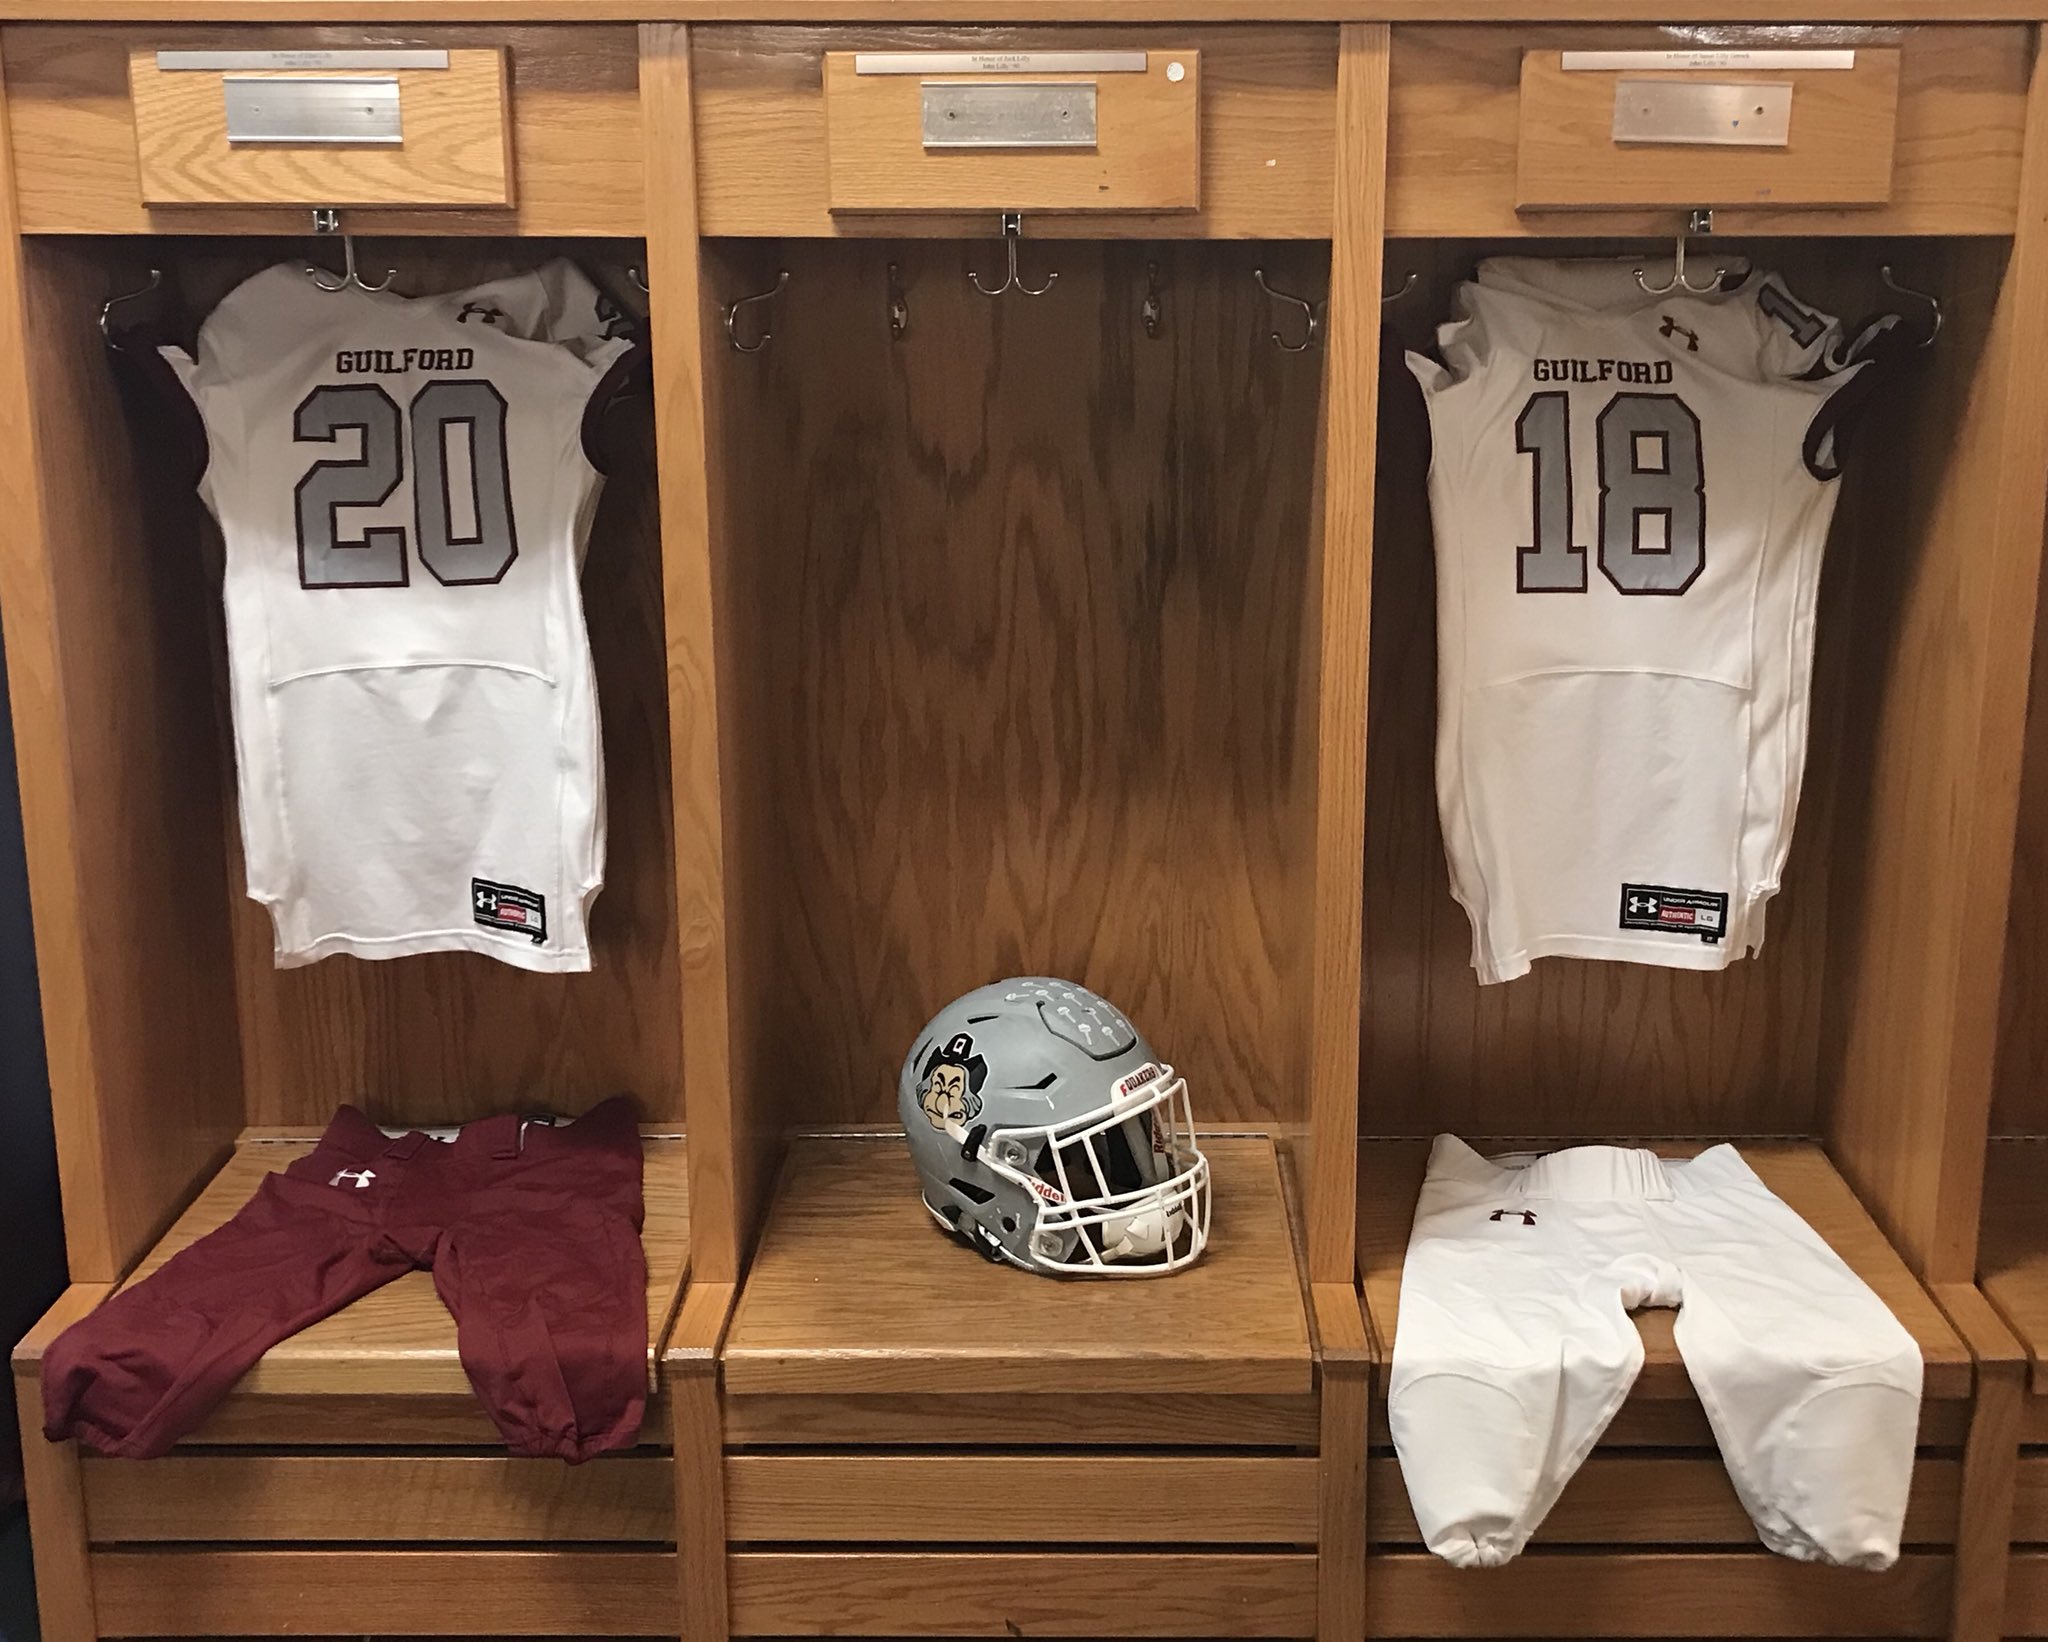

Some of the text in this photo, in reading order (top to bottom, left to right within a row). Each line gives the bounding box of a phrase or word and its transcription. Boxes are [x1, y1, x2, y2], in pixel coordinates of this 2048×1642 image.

[335, 348, 474, 374] GUILFORD
[1533, 358, 1673, 385] GUILFORD
[293, 379, 519, 590] 20
[1515, 390, 1707, 597] 18
